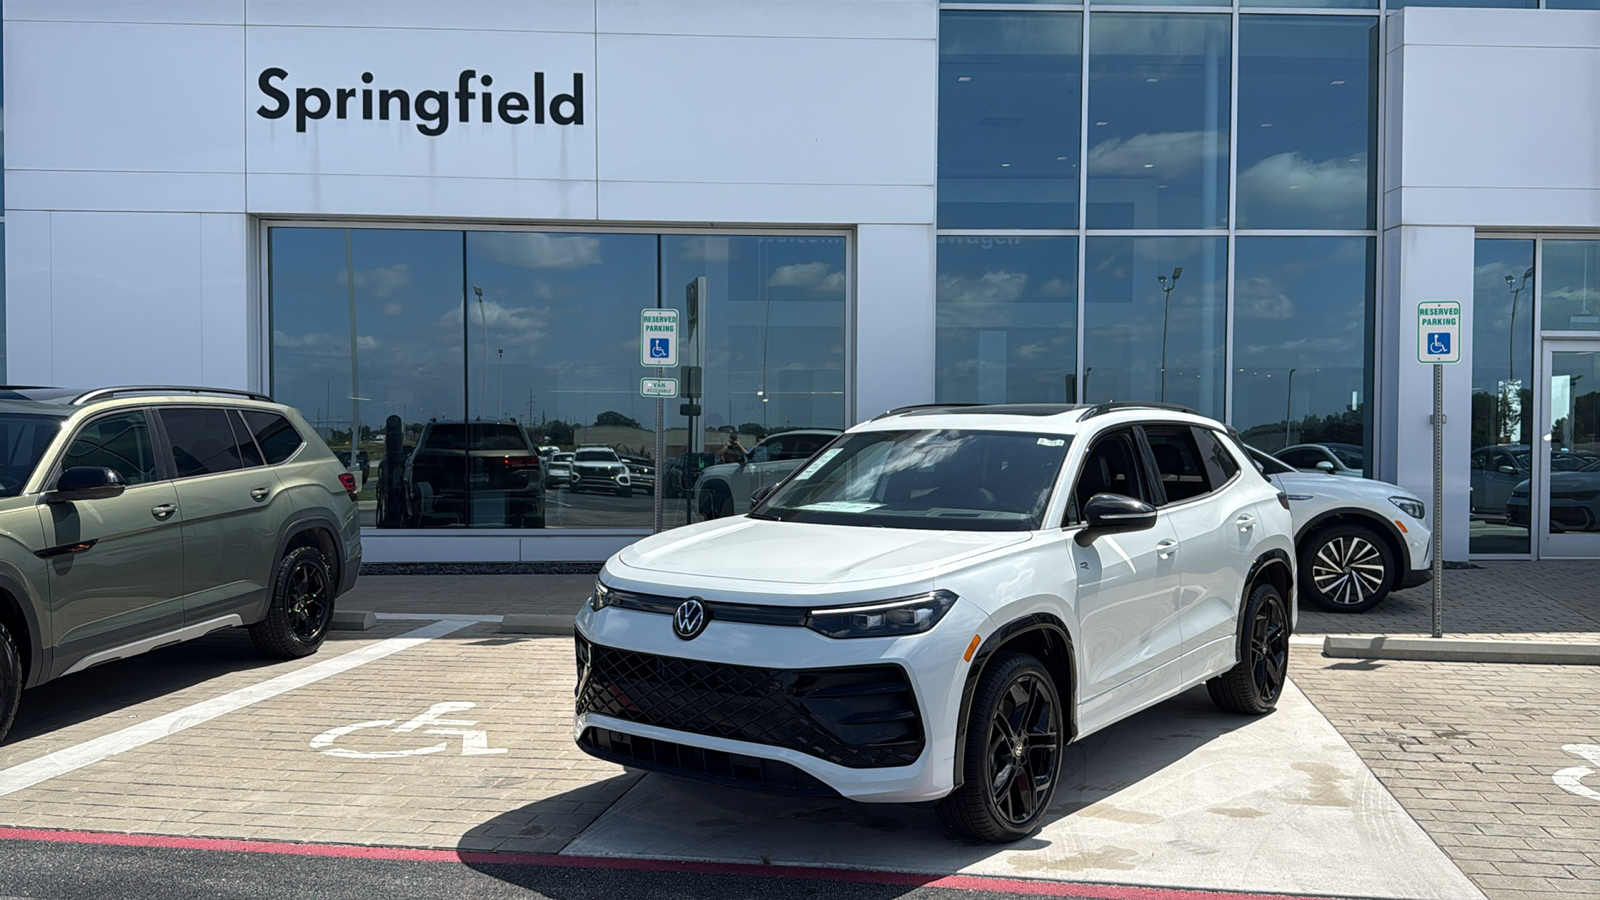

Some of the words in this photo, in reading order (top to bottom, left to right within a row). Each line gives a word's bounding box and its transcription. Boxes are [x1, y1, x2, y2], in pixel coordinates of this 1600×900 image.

[256, 67, 584, 136] Springfield
[1419, 307, 1459, 316] RESERVED
[643, 315, 676, 323] RESERVED
[1422, 317, 1456, 326] PARKING
[645, 324, 674, 332] PARKING
